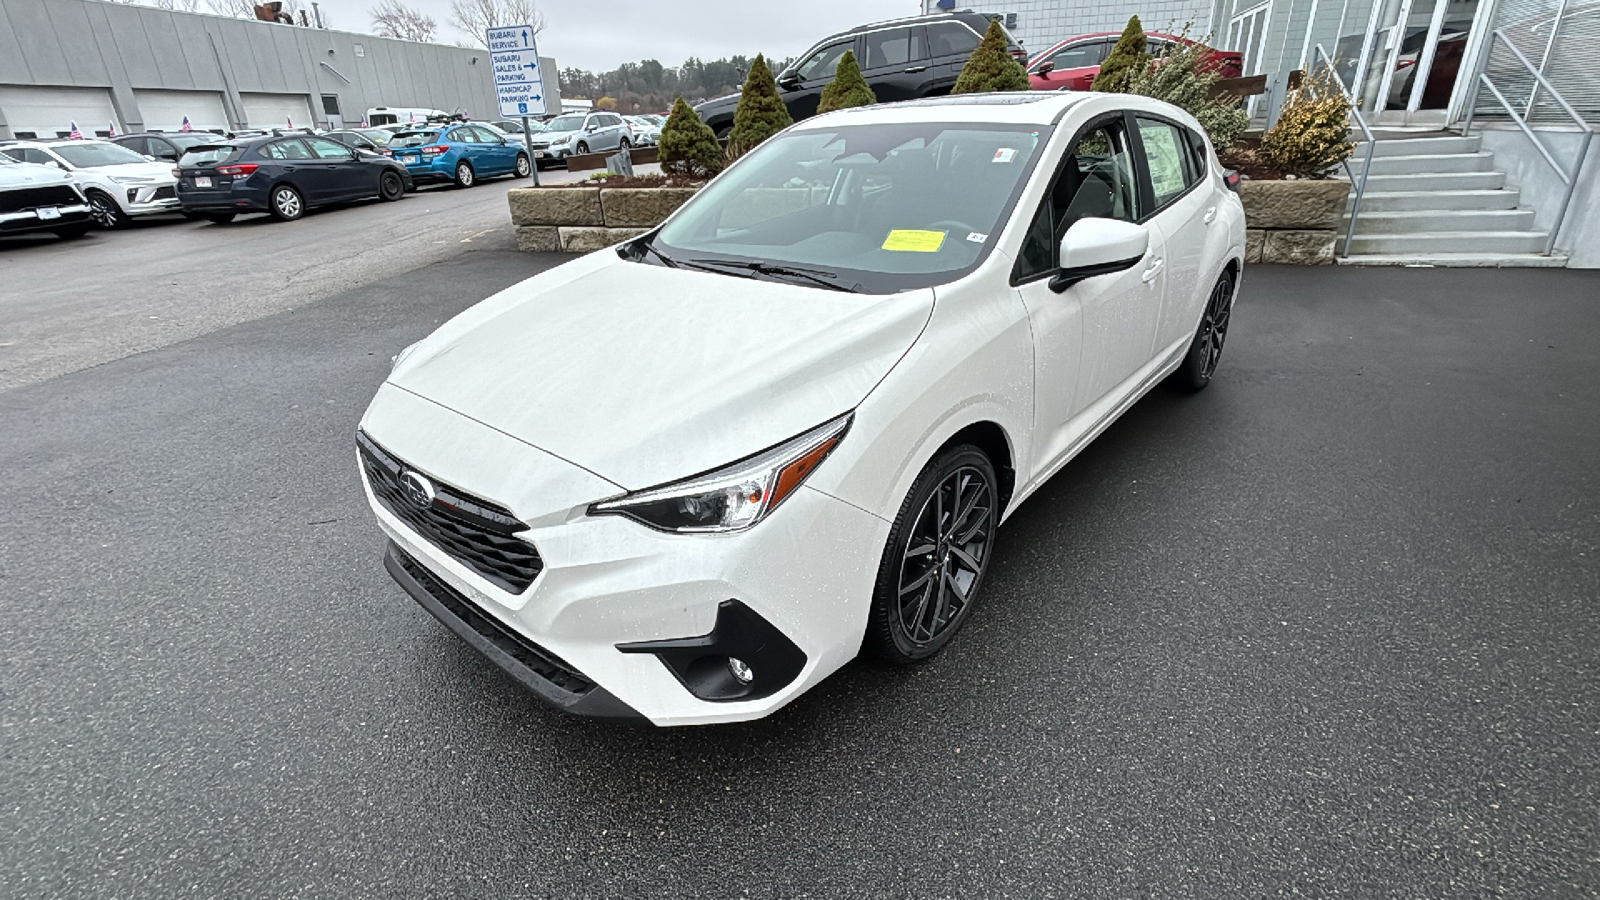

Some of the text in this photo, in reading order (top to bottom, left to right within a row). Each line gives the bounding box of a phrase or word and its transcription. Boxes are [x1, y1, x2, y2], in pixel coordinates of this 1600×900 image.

[490, 31, 516, 39] SUBARU
[491, 41, 518, 49] SERVICE
[494, 55, 520, 63] SUBARU
[497, 74, 525, 82] PARKING
[500, 85, 532, 93] HANDICAP
[501, 95, 529, 103] PARKING
